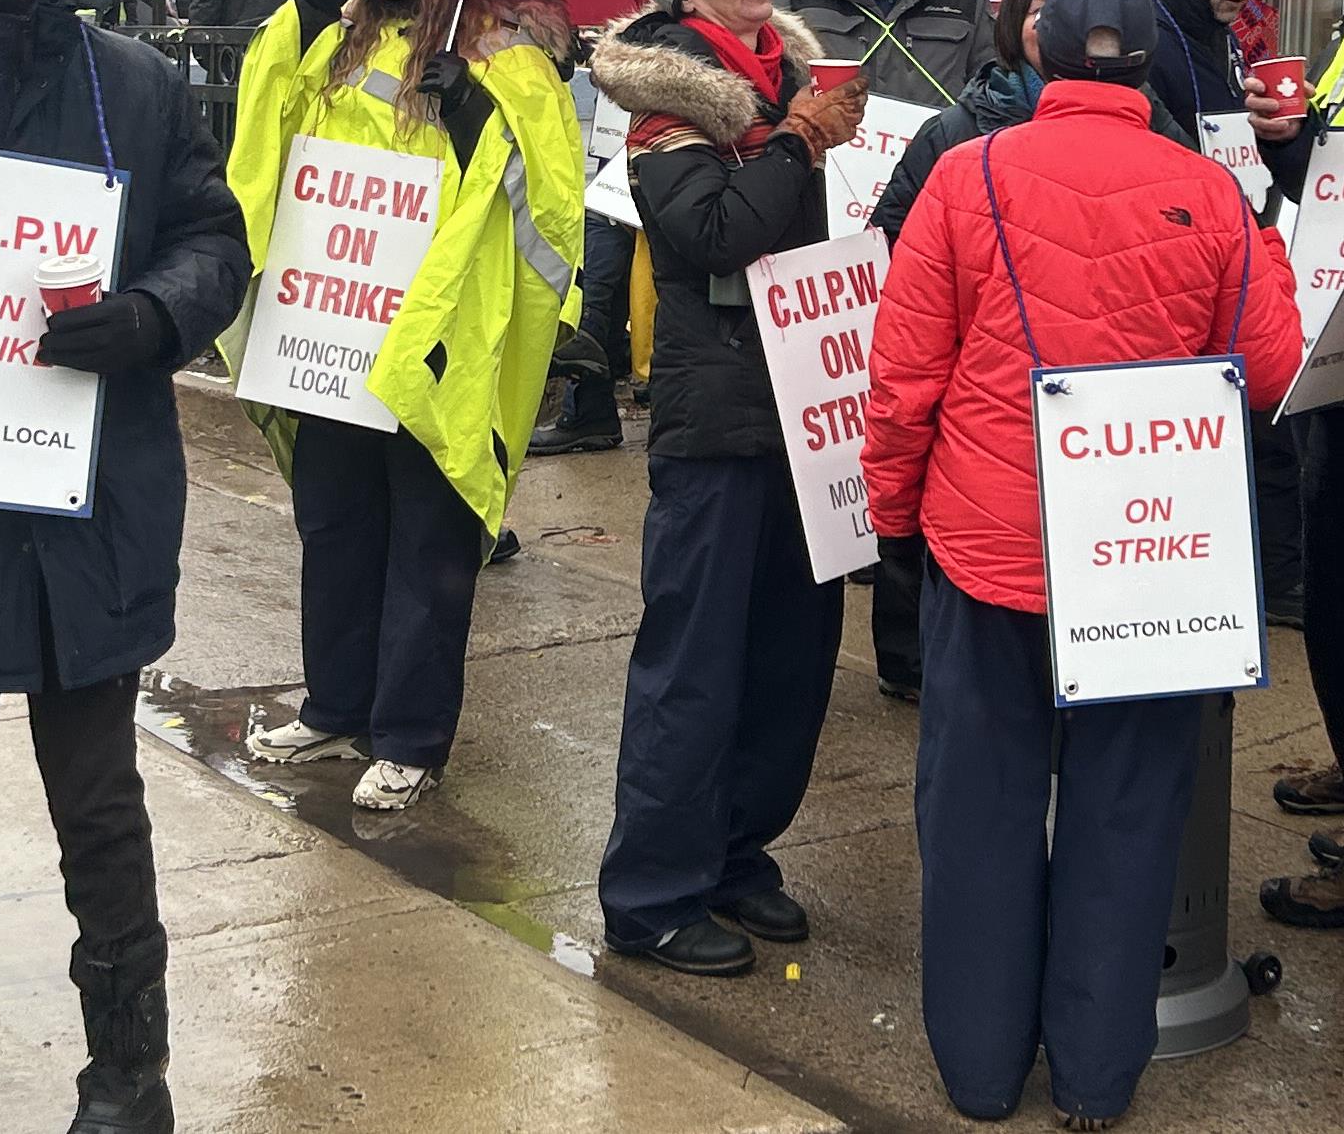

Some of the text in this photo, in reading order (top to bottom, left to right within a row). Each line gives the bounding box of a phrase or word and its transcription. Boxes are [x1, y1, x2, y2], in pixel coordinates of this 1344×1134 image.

[294, 164, 430, 223] C.U.P.W.
[326, 223, 378, 266] ON
[277, 268, 405, 325] STRIKE
[767, 261, 884, 329] C.U.P.W.
[277, 334, 378, 374] MONCTON
[820, 329, 866, 380] ON
[288, 366, 351, 400] LOCAL
[2, 425, 77, 450] LOCAL
[803, 388, 873, 452] STRI
[1059, 415, 1227, 460] C.U.P.W
[1124, 496, 1173, 525] ON
[1092, 531, 1212, 567] STRIKE
[1069, 613, 1245, 644] MONCTON LOCAL
